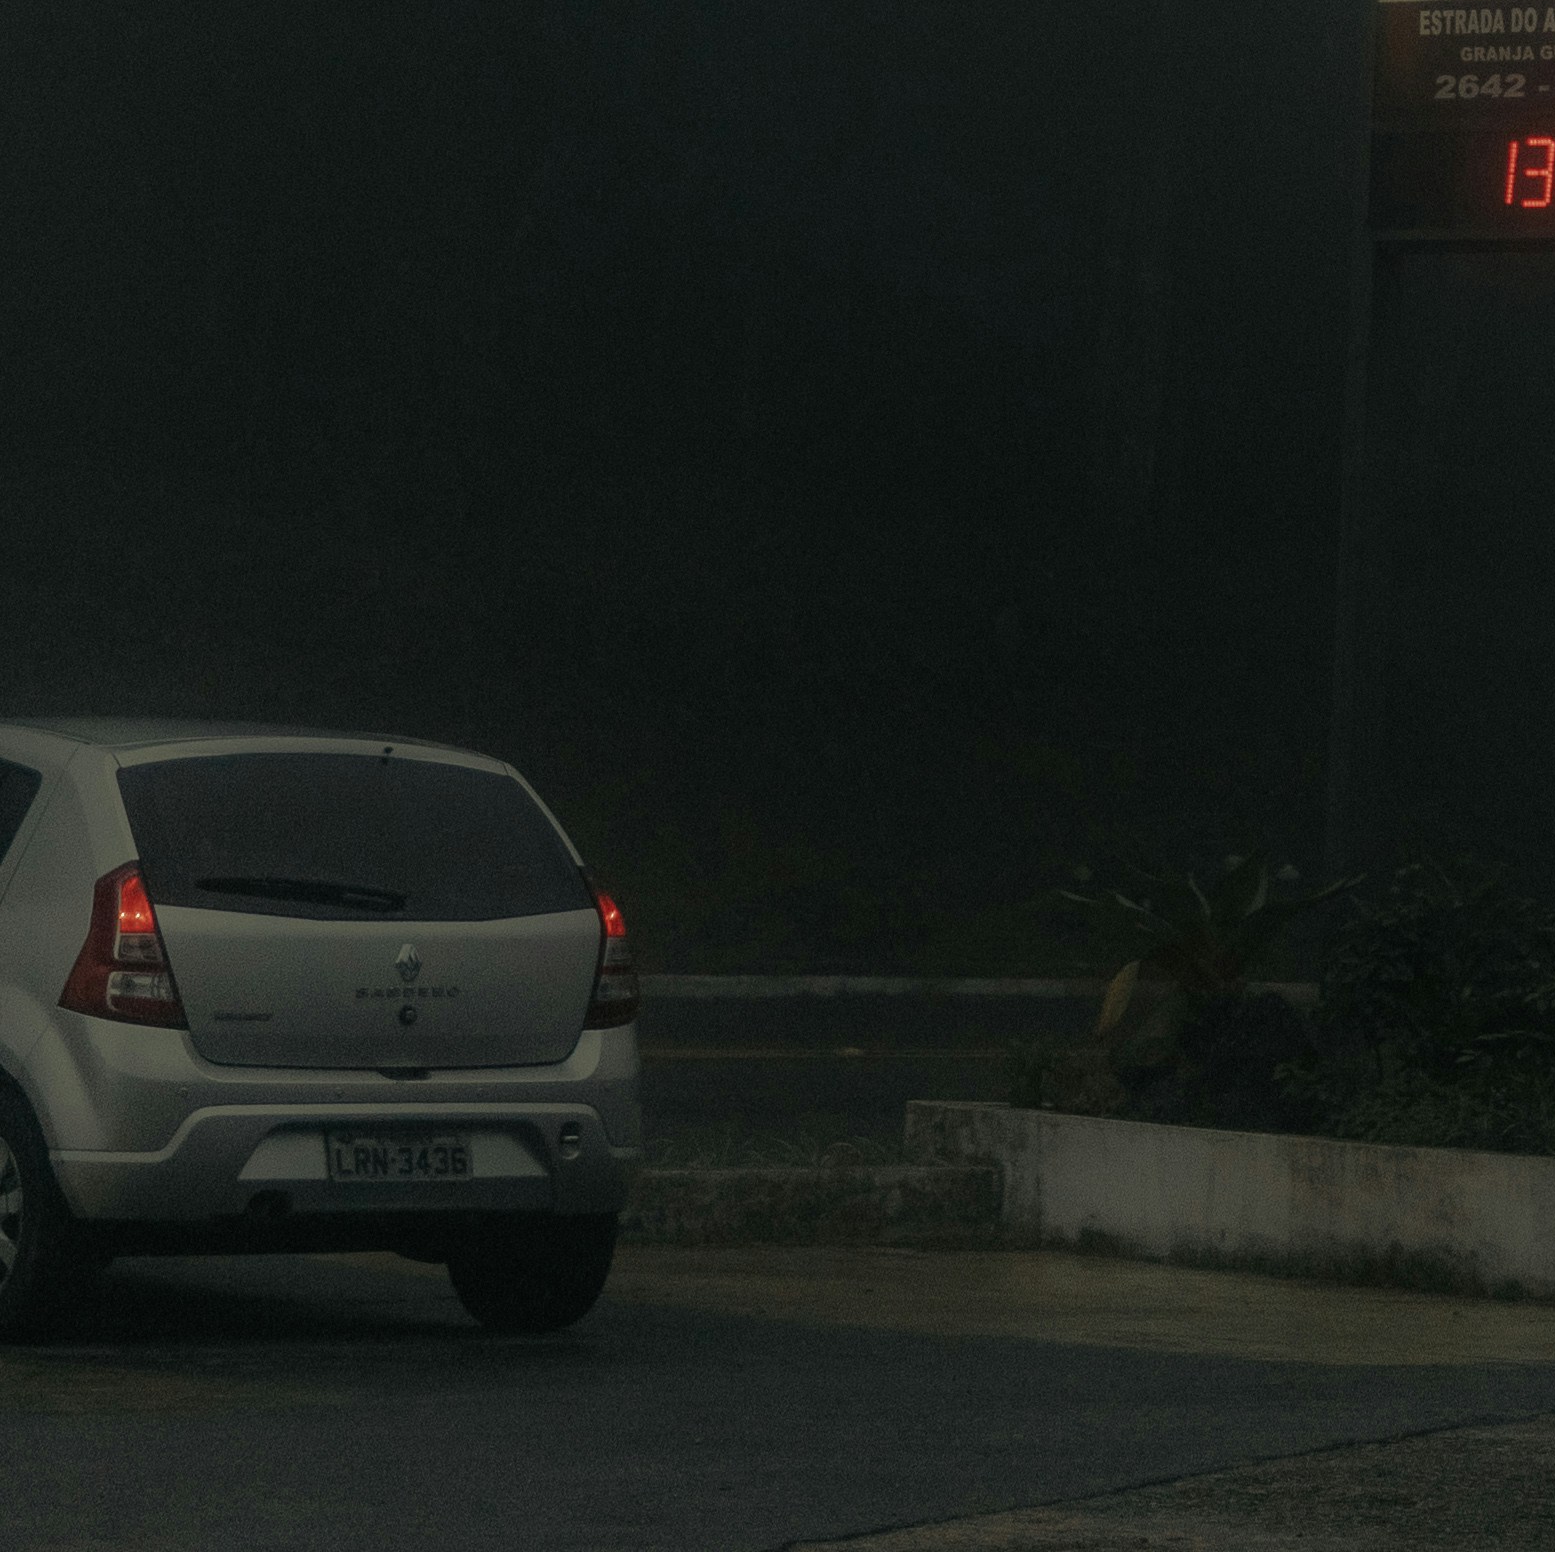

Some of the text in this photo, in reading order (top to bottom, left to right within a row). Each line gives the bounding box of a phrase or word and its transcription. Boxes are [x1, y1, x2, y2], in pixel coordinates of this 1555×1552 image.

[1419, 9, 1505, 36] ESTRADA
[1510, 7, 1538, 33] DO
[1460, 45, 1535, 62] GRANJA
[1434, 73, 1526, 99] 2642
